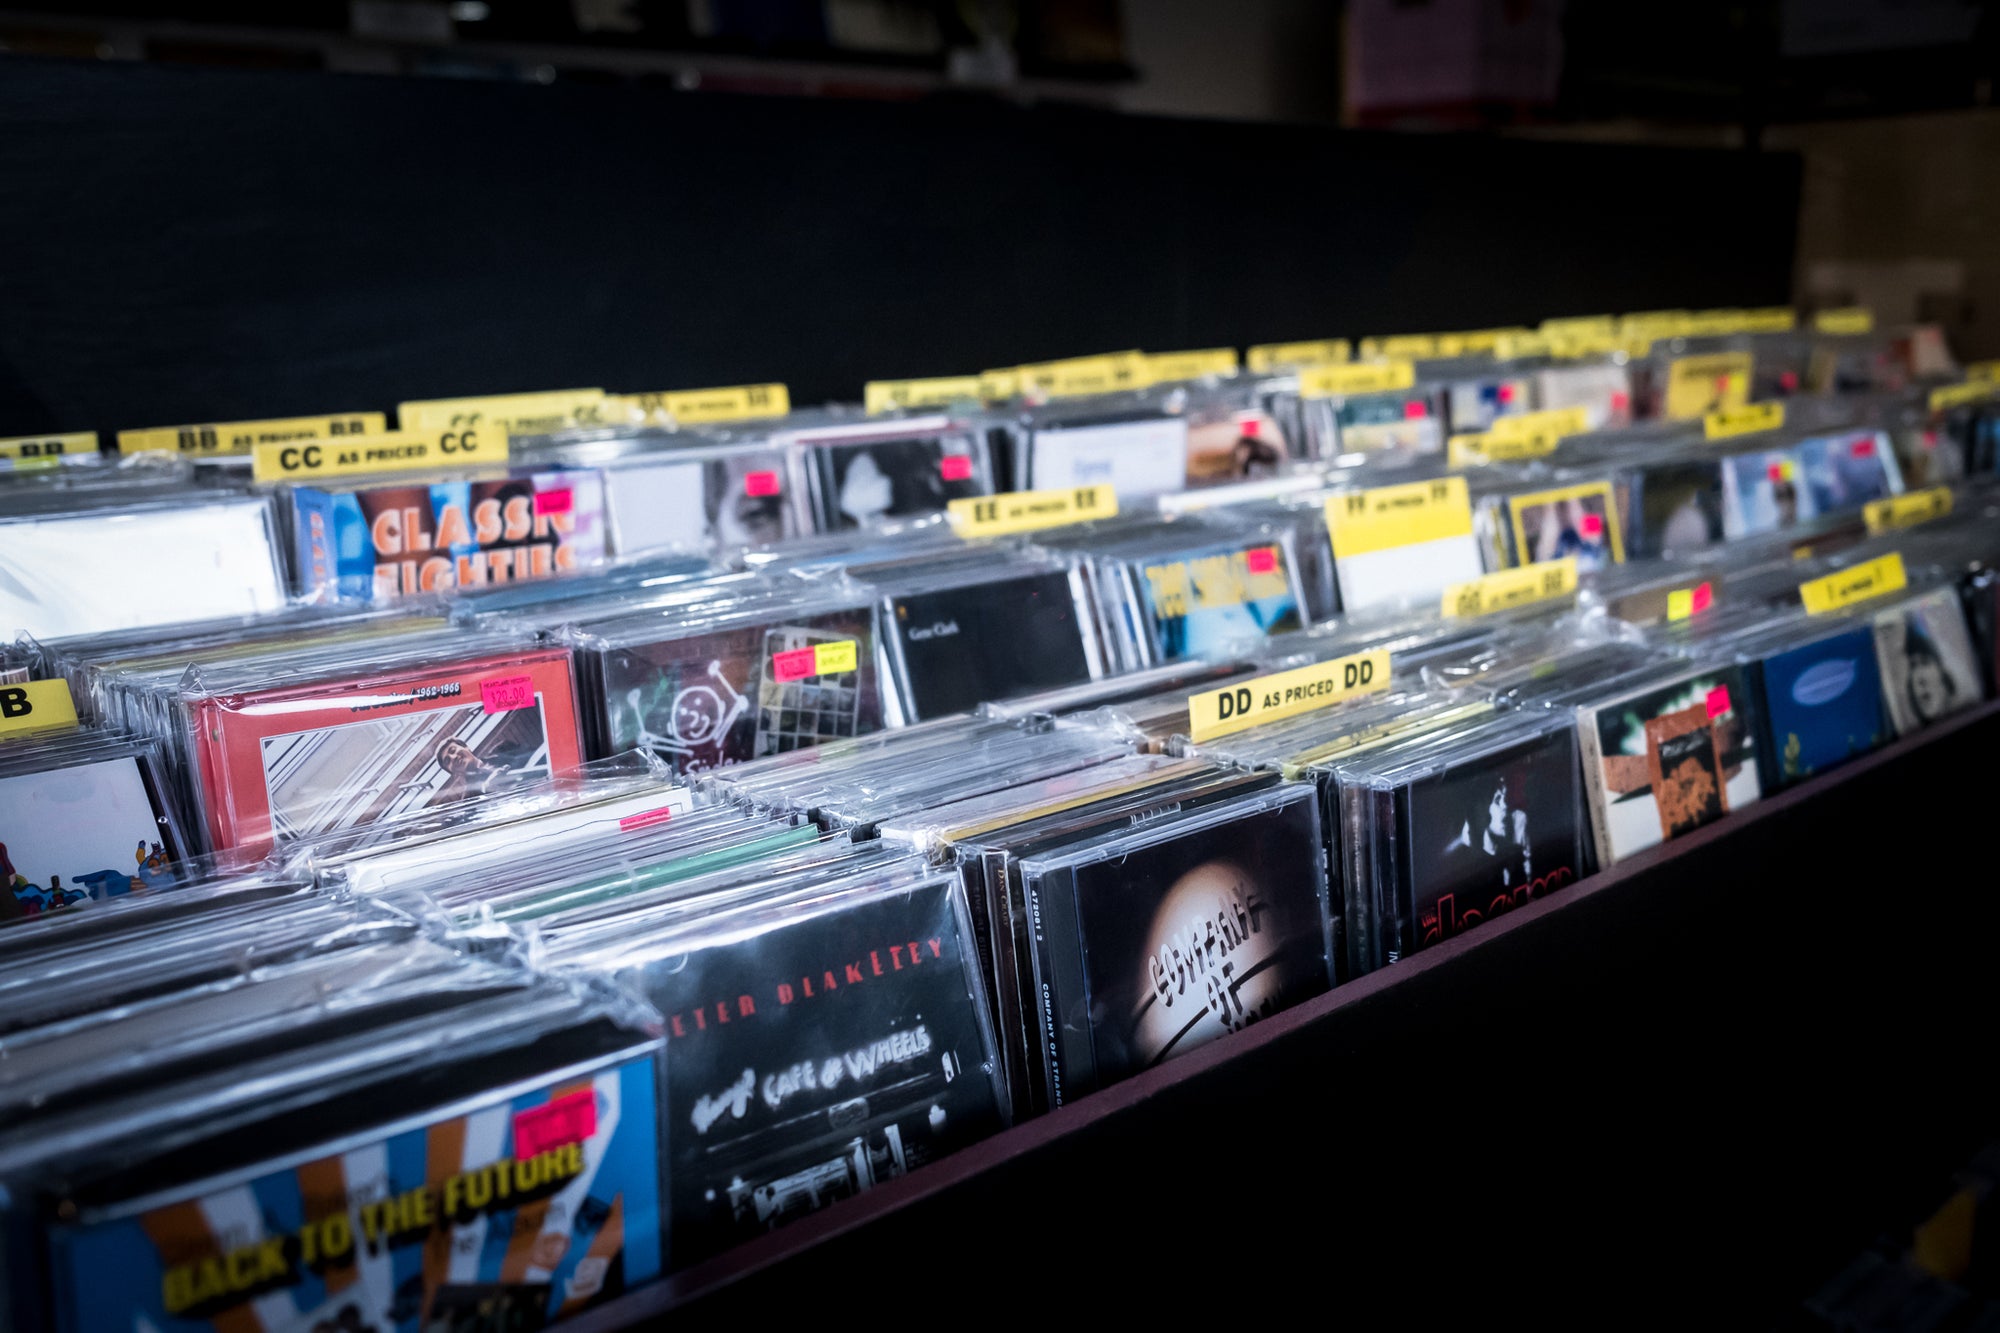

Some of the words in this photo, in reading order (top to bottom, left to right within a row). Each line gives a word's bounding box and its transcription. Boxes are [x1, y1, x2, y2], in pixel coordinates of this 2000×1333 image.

[280, 446, 322, 471] CC
[337, 451, 359, 465] AS
[366, 444, 427, 462] PRICED
[439, 430, 477, 454] CC
[372, 495, 575, 555] CLASSIC
[0, 687, 33, 719] B
[1218, 687, 1252, 720] DD
[1262, 692, 1280, 709] AS
[1285, 679, 1333, 703] PRICED
[1344, 660, 1373, 689] DD
[1031, 889, 1041, 929] 472081
[1149, 880, 1262, 1007] COMPANY
[671, 994, 756, 1038] ETER
[1042, 983, 1055, 1038] COMPANY
[1050, 1042, 1057, 1056] OF
[844, 1024, 932, 1081] WHEELS
[162, 1234, 291, 1315] BACK
[303, 1210, 353, 1262] TO
[361, 1187, 436, 1240] THE
[443, 1140, 587, 1218] FUTURE
